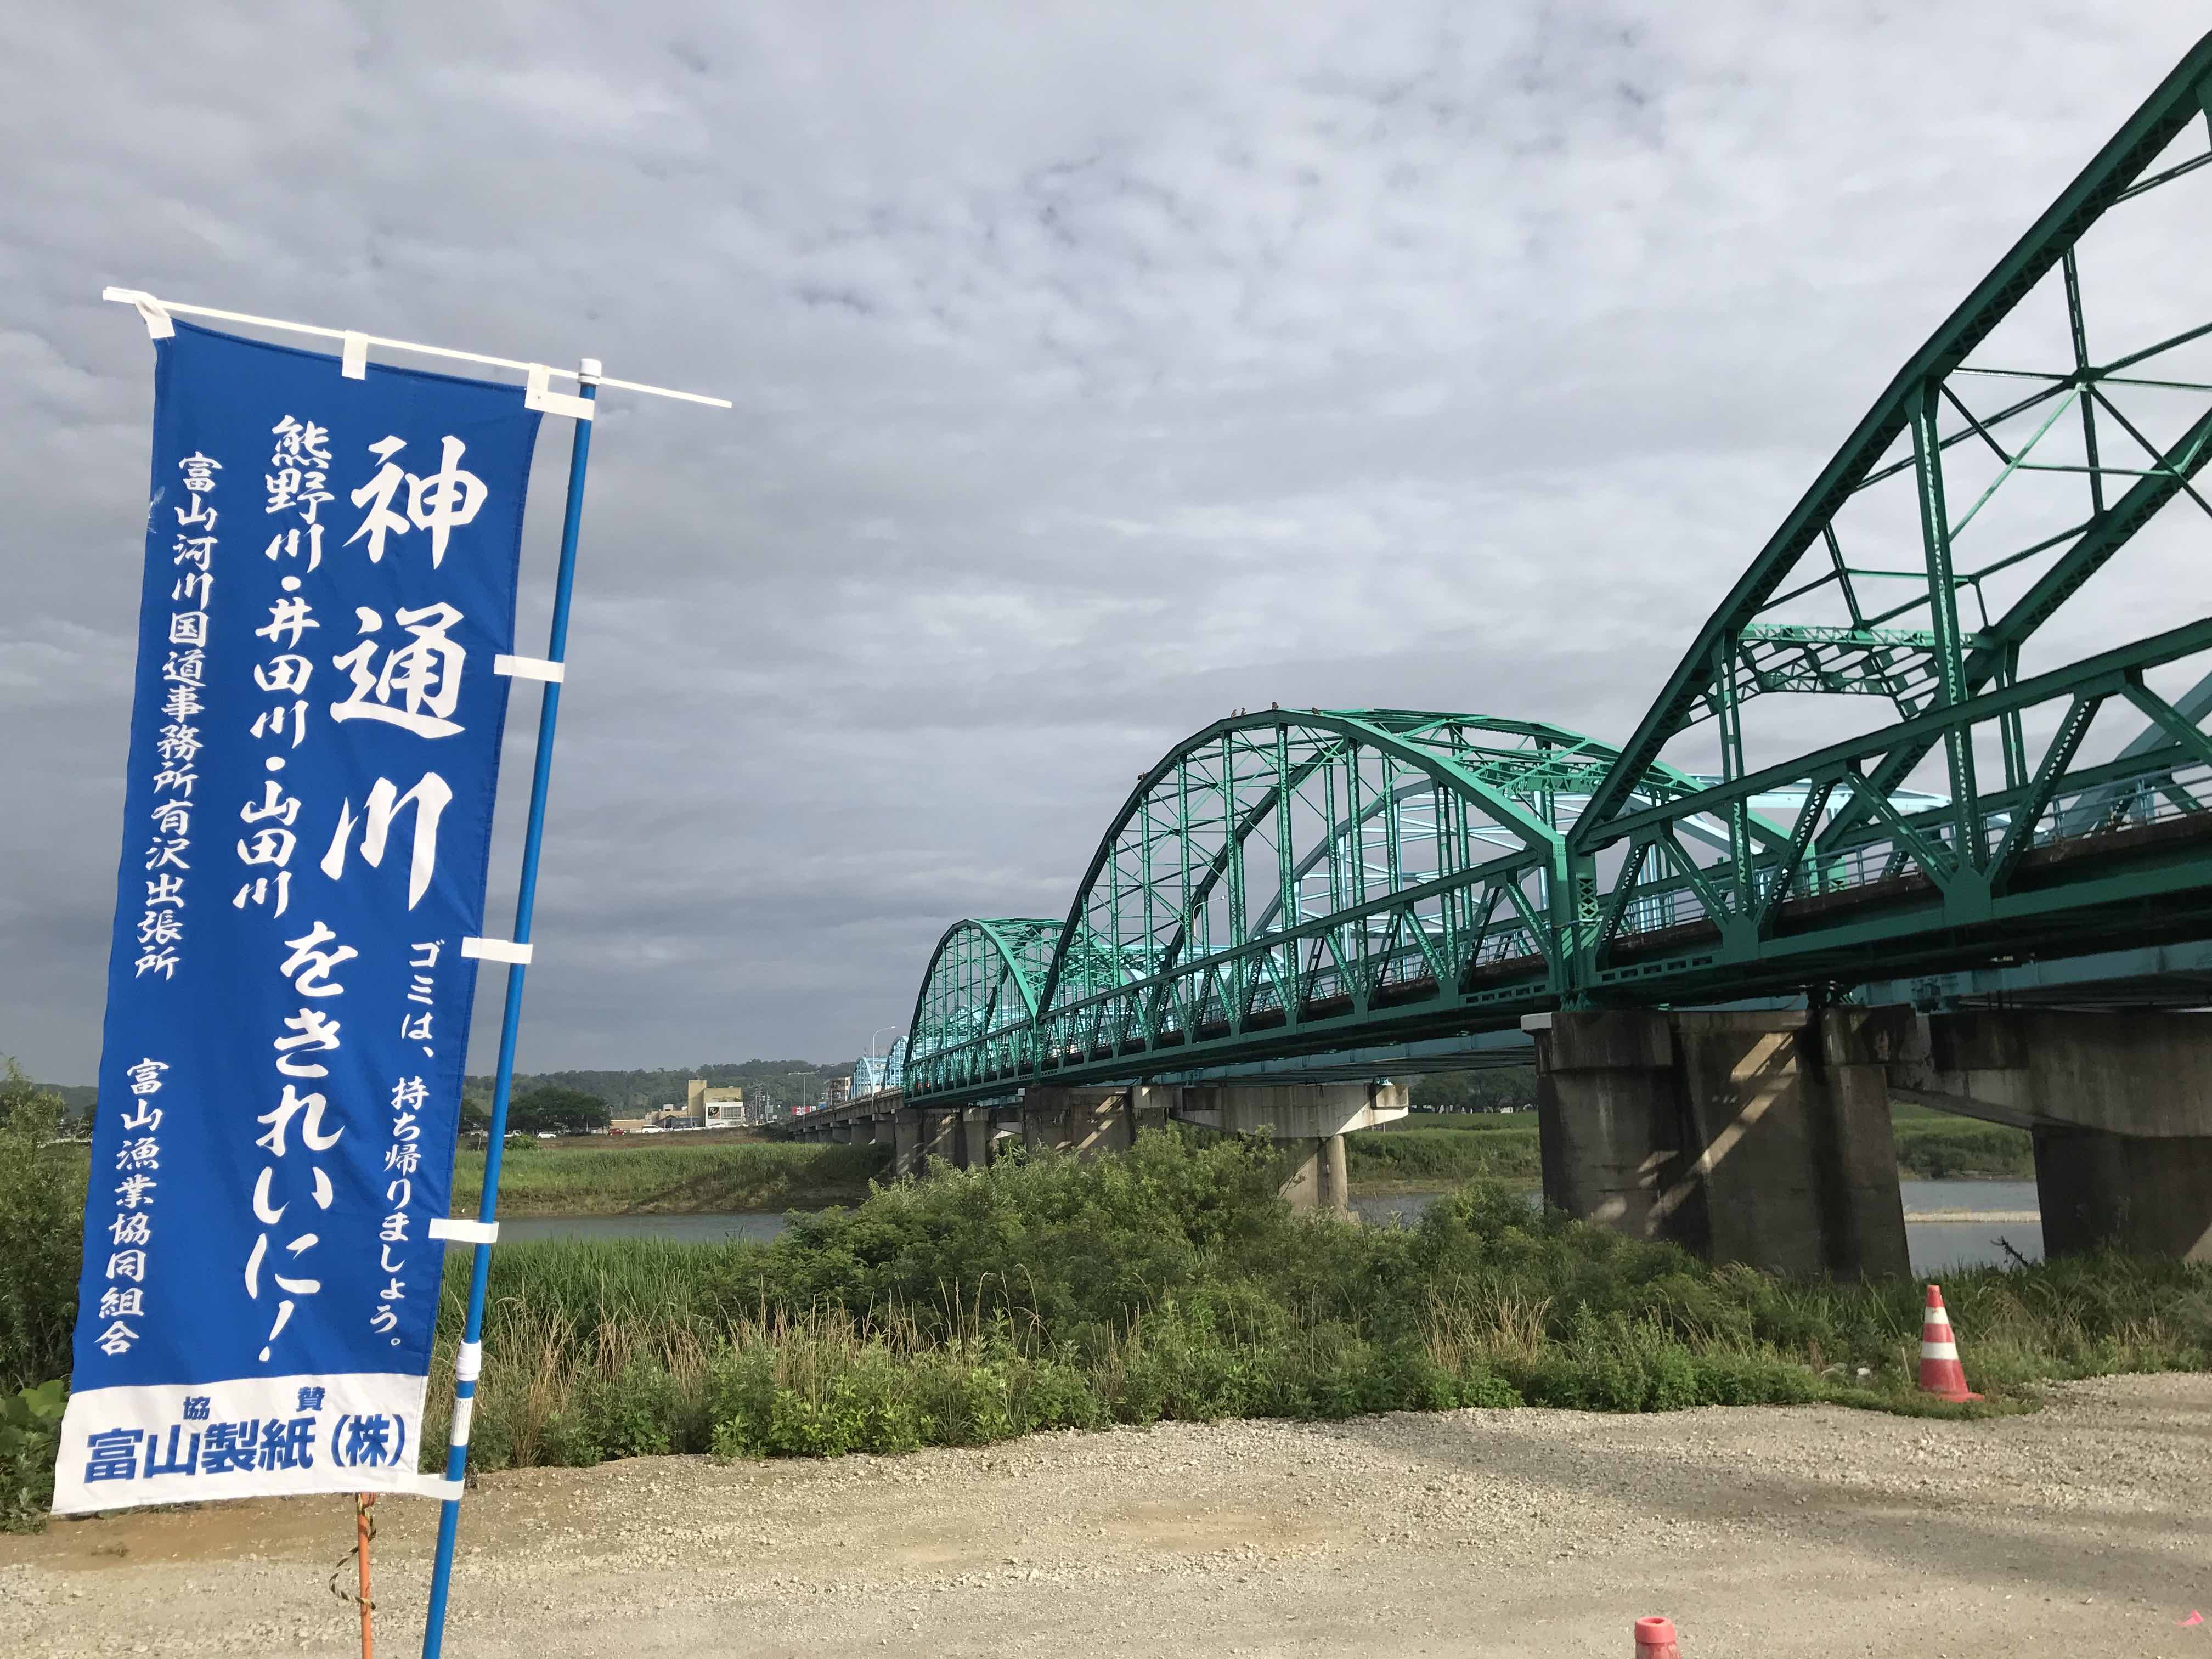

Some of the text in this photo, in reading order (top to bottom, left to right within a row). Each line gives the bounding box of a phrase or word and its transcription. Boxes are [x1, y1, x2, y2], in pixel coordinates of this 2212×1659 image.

[320, 435, 488, 911] 神通川
[97, 1058, 169, 1356] 富山漁業協同組合
[244, 921, 358, 1362] をきれいに!
